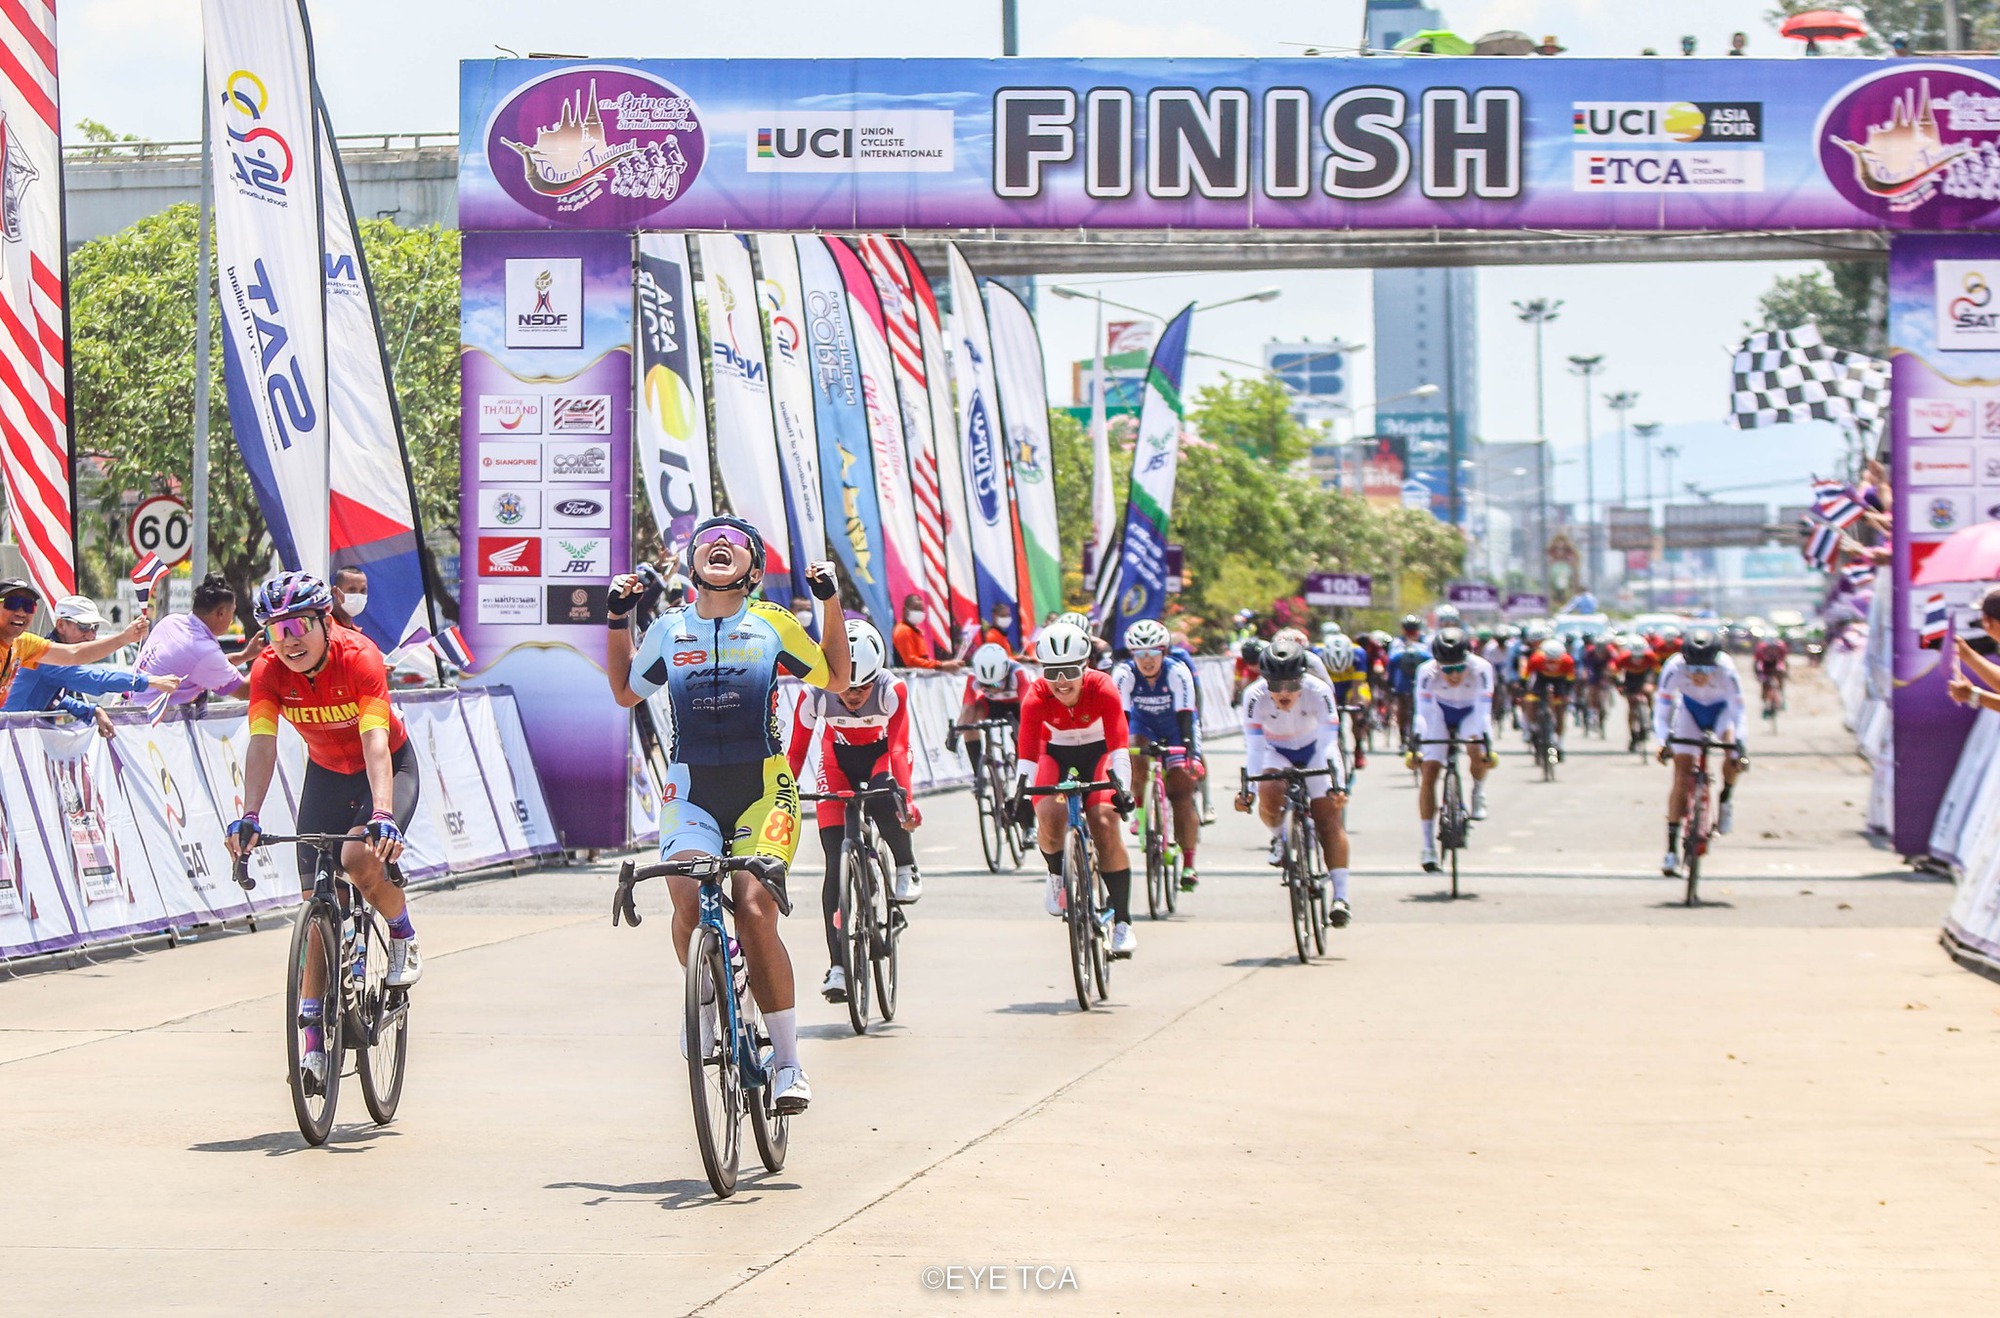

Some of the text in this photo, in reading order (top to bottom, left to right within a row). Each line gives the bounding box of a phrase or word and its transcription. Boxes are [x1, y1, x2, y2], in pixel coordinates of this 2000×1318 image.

[617, 91, 691, 112] Princess
[618, 110, 688, 120] Maha Chakri
[1710, 109, 1751, 122] ASIA
[677, 120, 699, 132] Cup
[1589, 109, 1657, 136] UCI
[1710, 122, 1757, 136] TOUR
[861, 128, 894, 136] UNION
[776, 128, 853, 158] UCI
[861, 139, 905, 147] CYCLISTE
[993, 86, 1522, 199] FINISH
[534, 139, 637, 182] Tour of Thailand
[861, 150, 944, 158] INTERNATIONALE
[1608, 157, 1690, 185] TCA
[518, 314, 568, 326] NSDF
[484, 405, 538, 415] THAILAND
[563, 502, 595, 515] Ford
[139, 515, 188, 550] 60
[561, 560, 596, 573] FBT
[1132, 695, 1173, 703] CHINESE
[281, 701, 360, 724] VIETNAM
